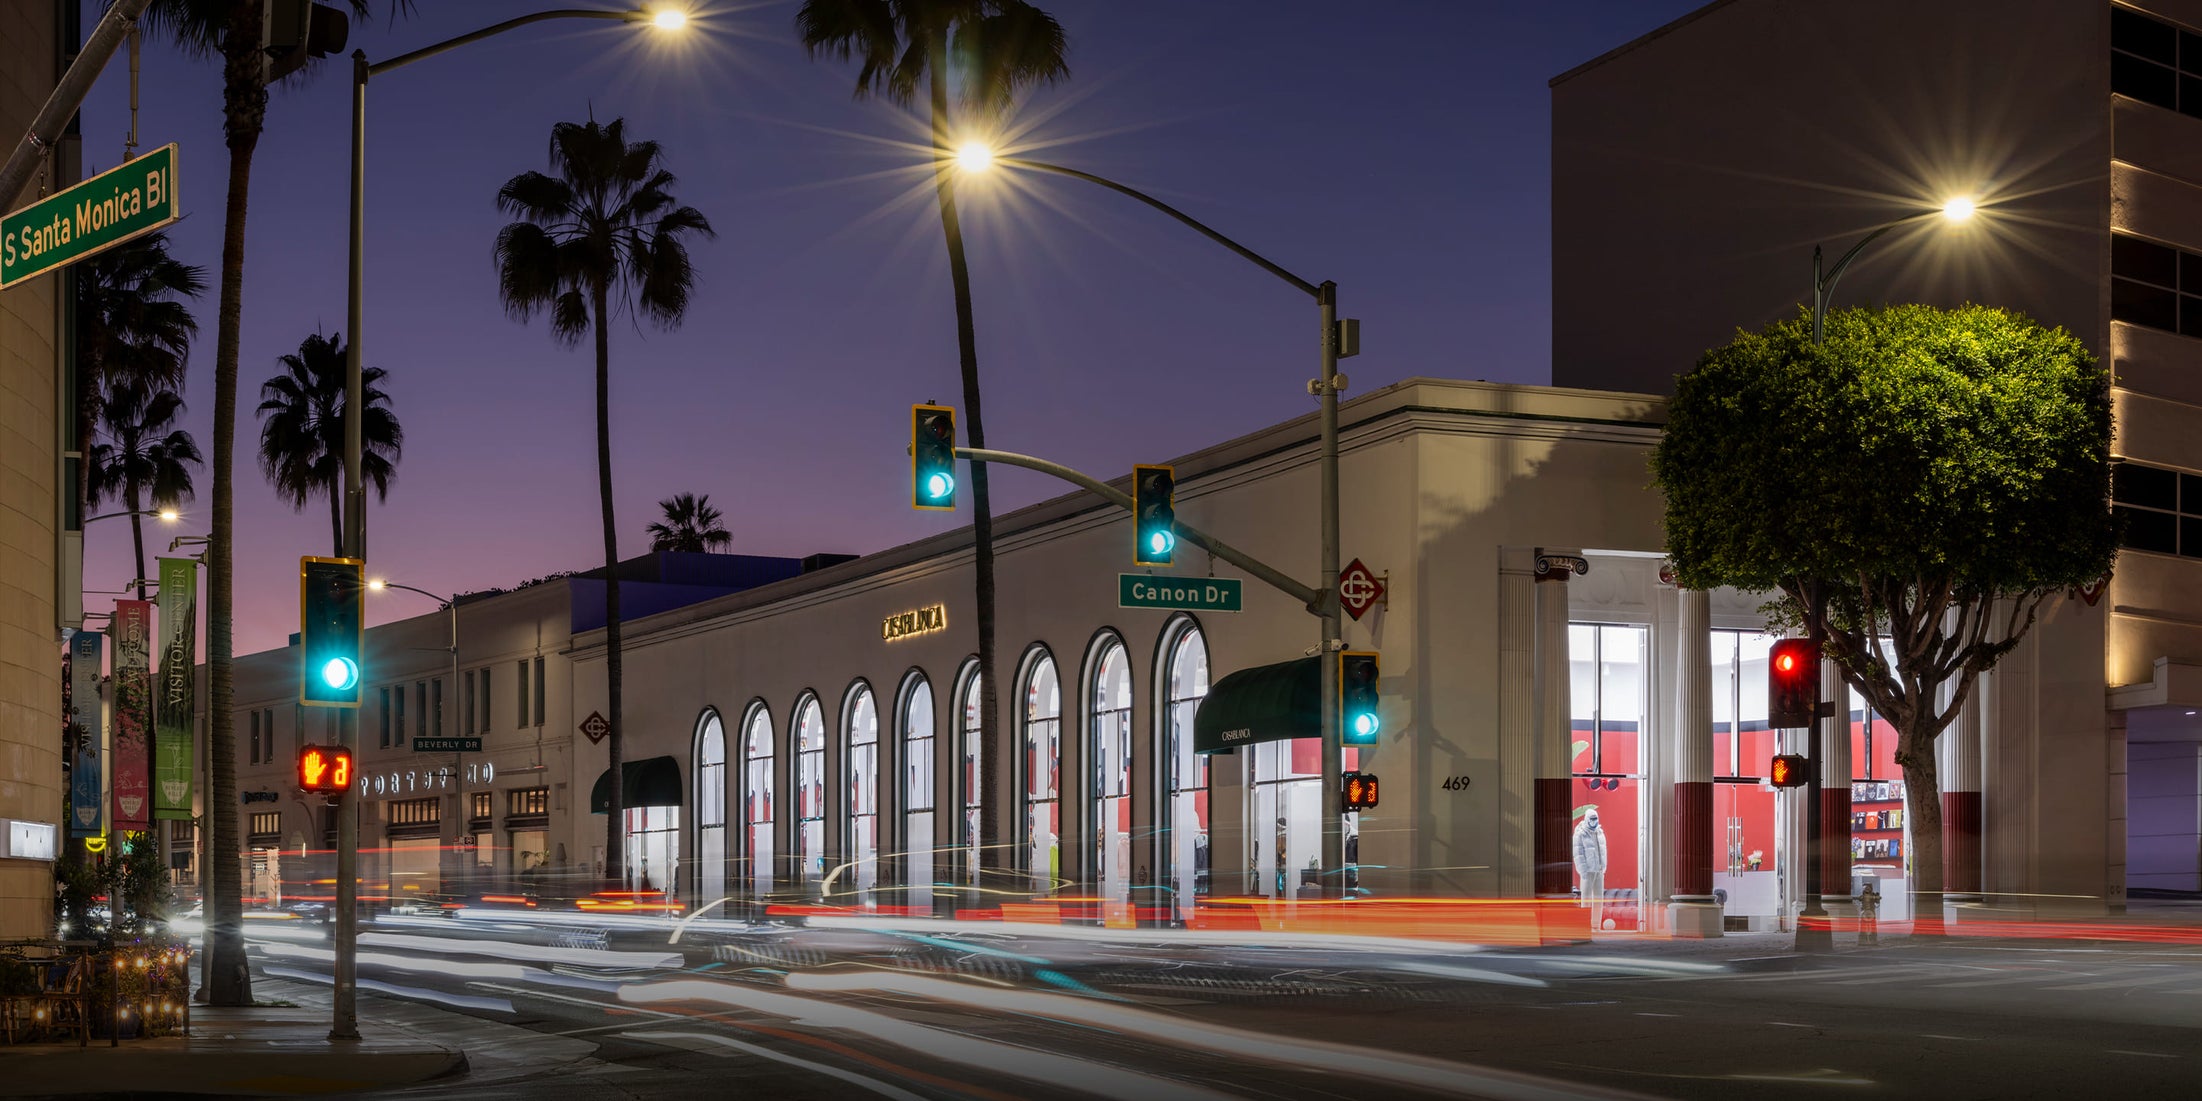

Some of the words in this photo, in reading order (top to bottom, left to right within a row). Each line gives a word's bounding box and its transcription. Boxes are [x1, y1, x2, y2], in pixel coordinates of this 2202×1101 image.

[4, 232, 16, 267] S
[20, 213, 71, 261] Santa
[75, 187, 141, 239] Monica
[171, 568, 185, 633] CENTER
[1132, 582, 1199, 602] Canon
[1206, 586, 1229, 603] Dr
[127, 607, 140, 683] WELCOME
[170, 640, 184, 705] VISITOR
[417, 740, 459, 748] BEVERLY
[465, 741, 478, 749] DR
[1441, 776, 1471, 791] 469
